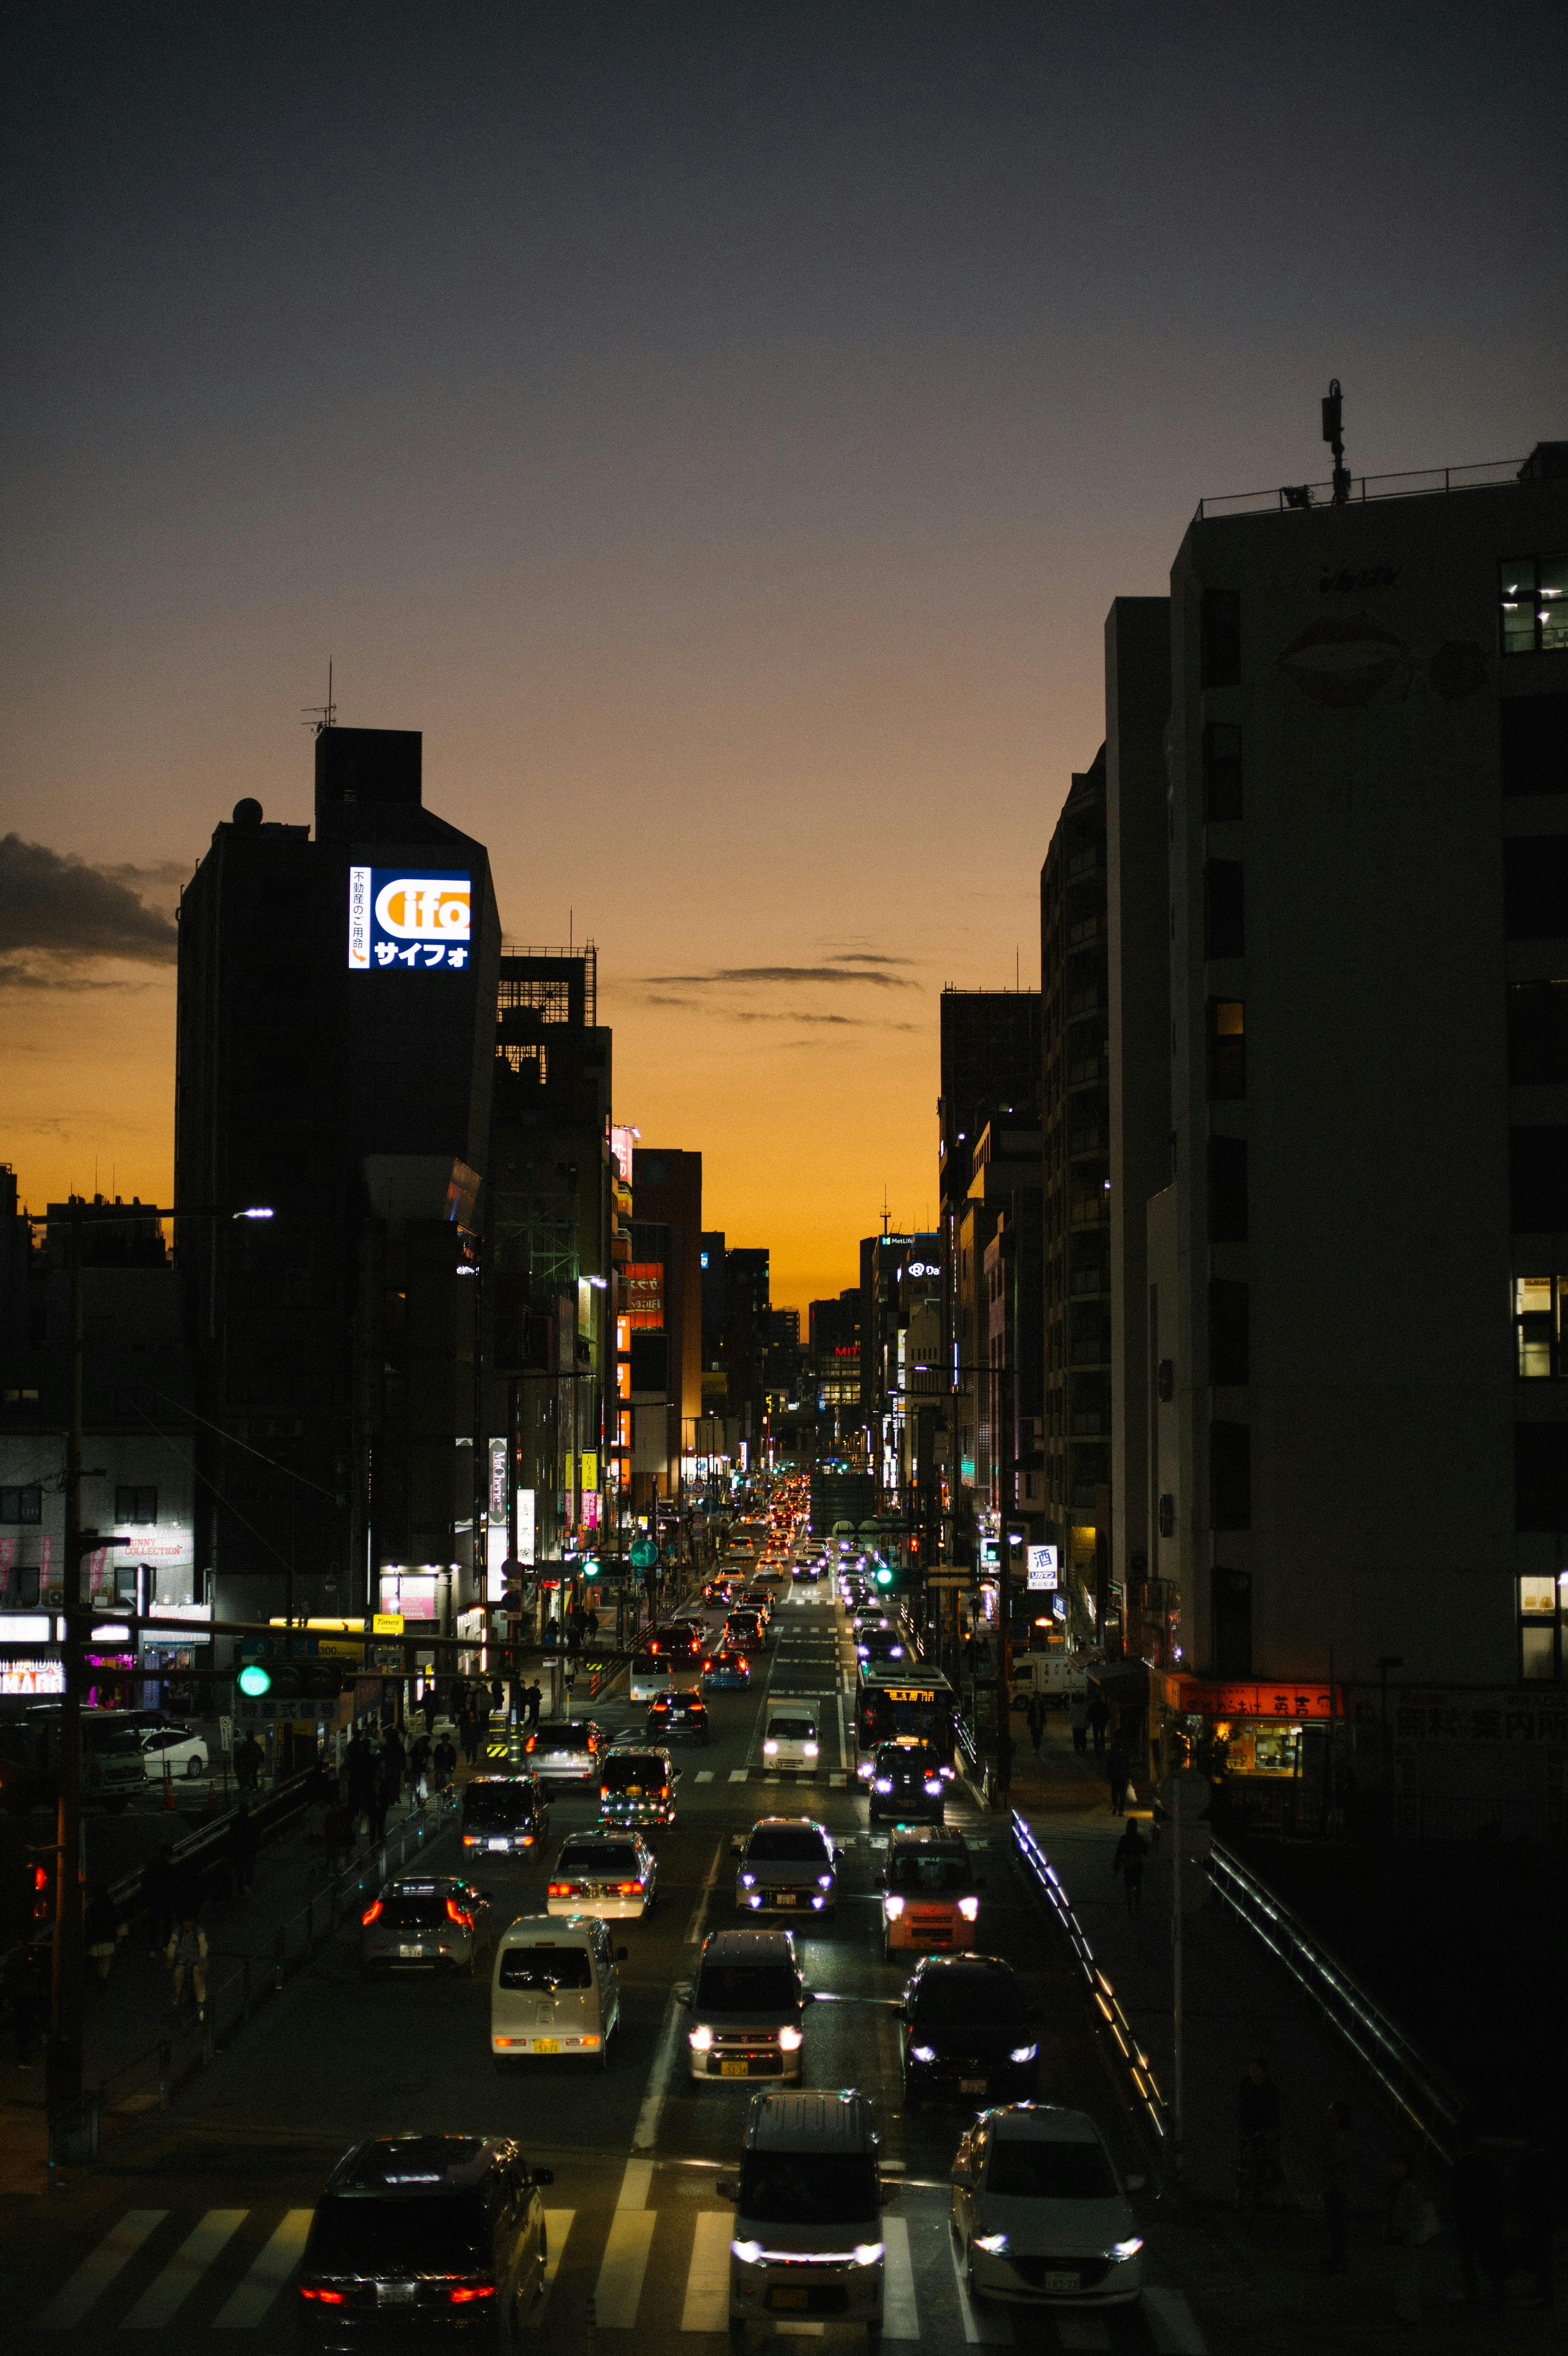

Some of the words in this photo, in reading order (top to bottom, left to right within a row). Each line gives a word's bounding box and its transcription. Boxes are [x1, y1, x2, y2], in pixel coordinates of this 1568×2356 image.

[353, 872, 364, 949] 不動産のご用命
[374, 942, 468, 968] サイフォ
[494, 1451, 505, 1503] MaCherie
[125, 1547, 180, 1555] COLLECTION
[130, 1538, 156, 1547] UNNY
[1034, 1549, 1052, 1568] 酒
[319, 1647, 337, 1655] 300
